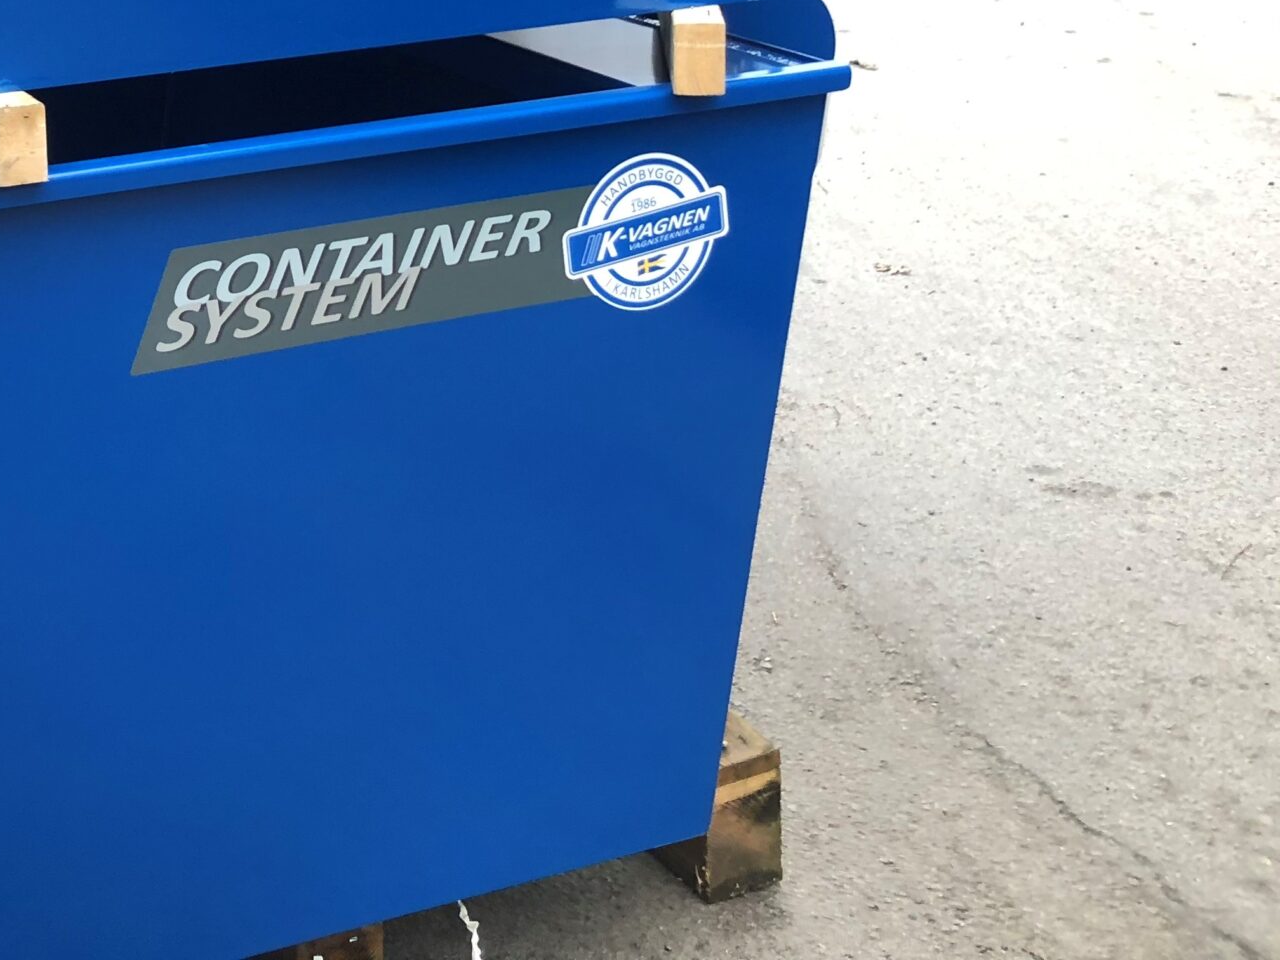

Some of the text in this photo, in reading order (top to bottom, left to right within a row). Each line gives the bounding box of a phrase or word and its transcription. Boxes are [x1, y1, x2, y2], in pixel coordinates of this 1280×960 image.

[600, 167, 684, 207] HANDBYGGD
[630, 196, 657, 213] 1986
[597, 204, 711, 262] K-VAGNEN
[628, 223, 706, 251] VAGNSTEKNIK AB
[173, 209, 552, 309] CONTAINER
[612, 263, 691, 300] KARLSHAMN
[155, 264, 422, 353] SYSTEM
